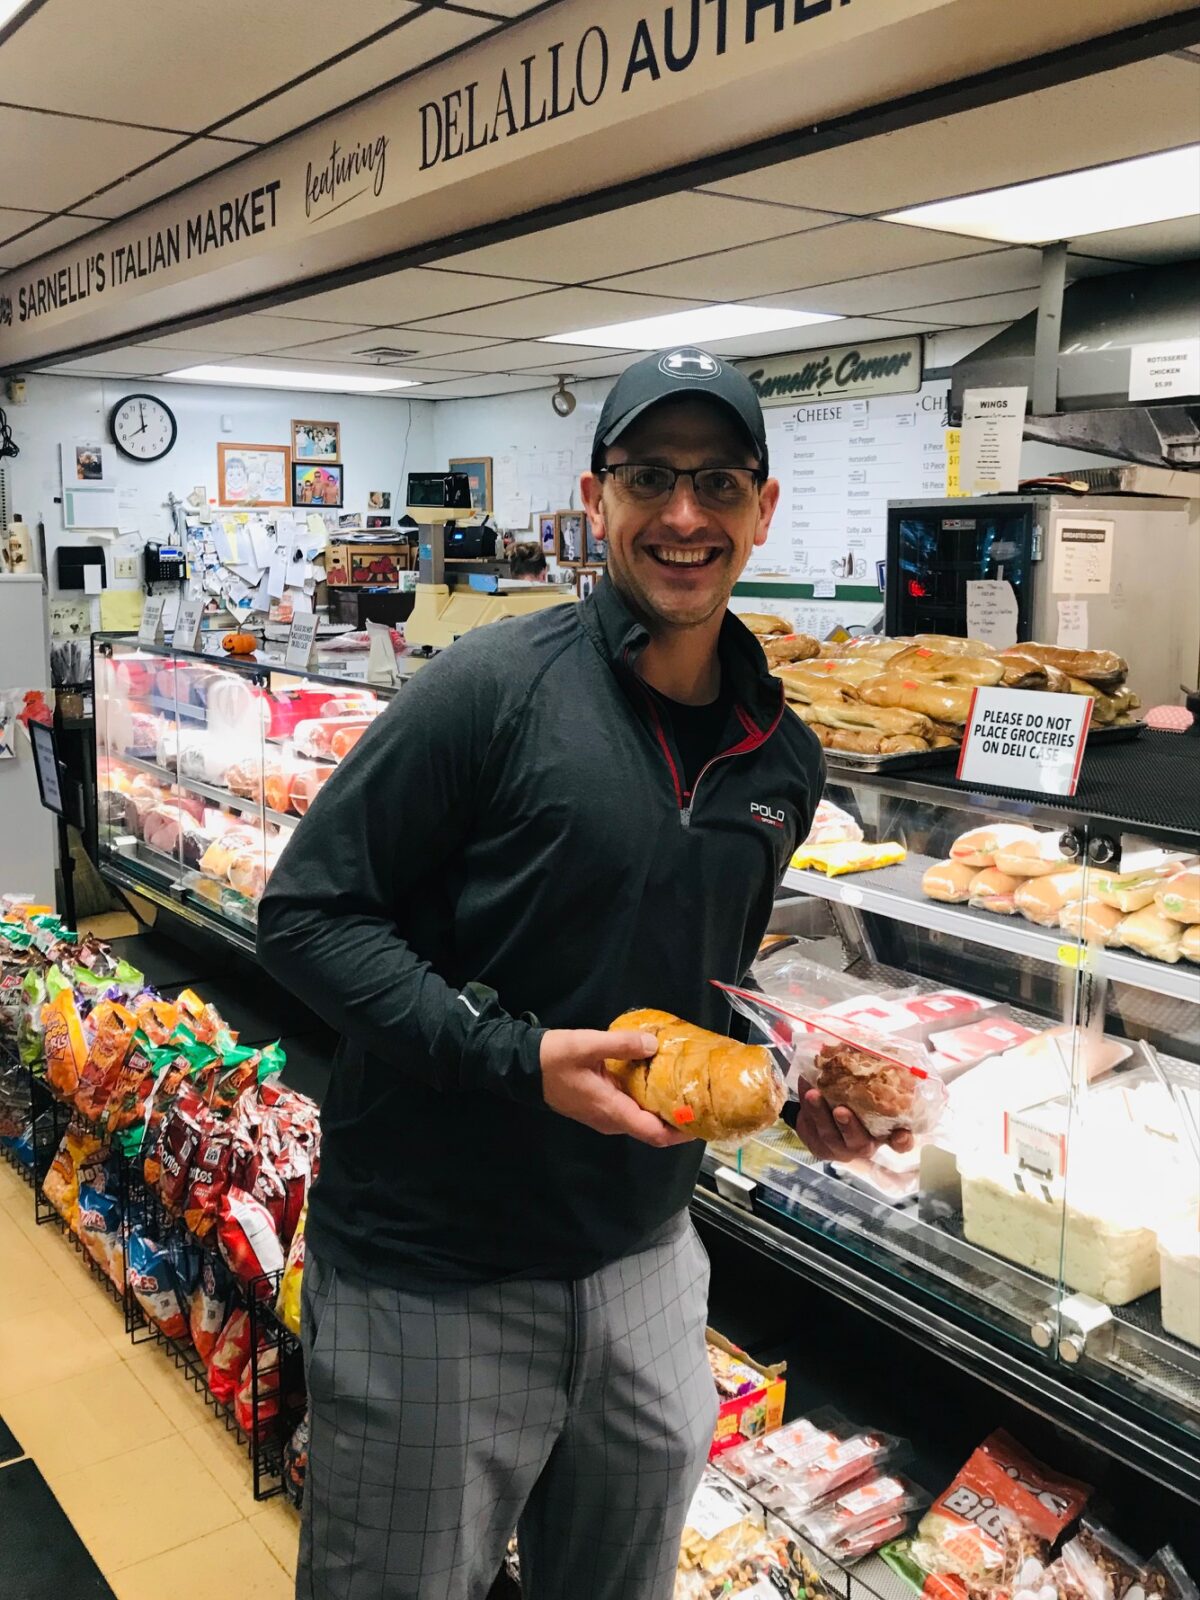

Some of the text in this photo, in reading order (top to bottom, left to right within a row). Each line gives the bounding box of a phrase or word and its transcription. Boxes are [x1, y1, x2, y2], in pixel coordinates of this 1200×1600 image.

[18, 251, 106, 323] SARNELLI'S
[111, 224, 181, 288] ITALIAN
[187, 180, 282, 260] MARKET
[304, 133, 391, 219] featuring
[419, 25, 610, 172] DELALLO
[1149, 368, 1181, 376] CHICKEN
[797, 406, 842, 423] CHEESE
[980, 400, 1008, 409] WINGS
[983, 710, 1072, 731] PLEASE DO NOT
[974, 724, 1075, 748] PLACE GROCERIES
[982, 741, 1059, 761] ON DELI CASE
[750, 802, 785, 822] POLO
